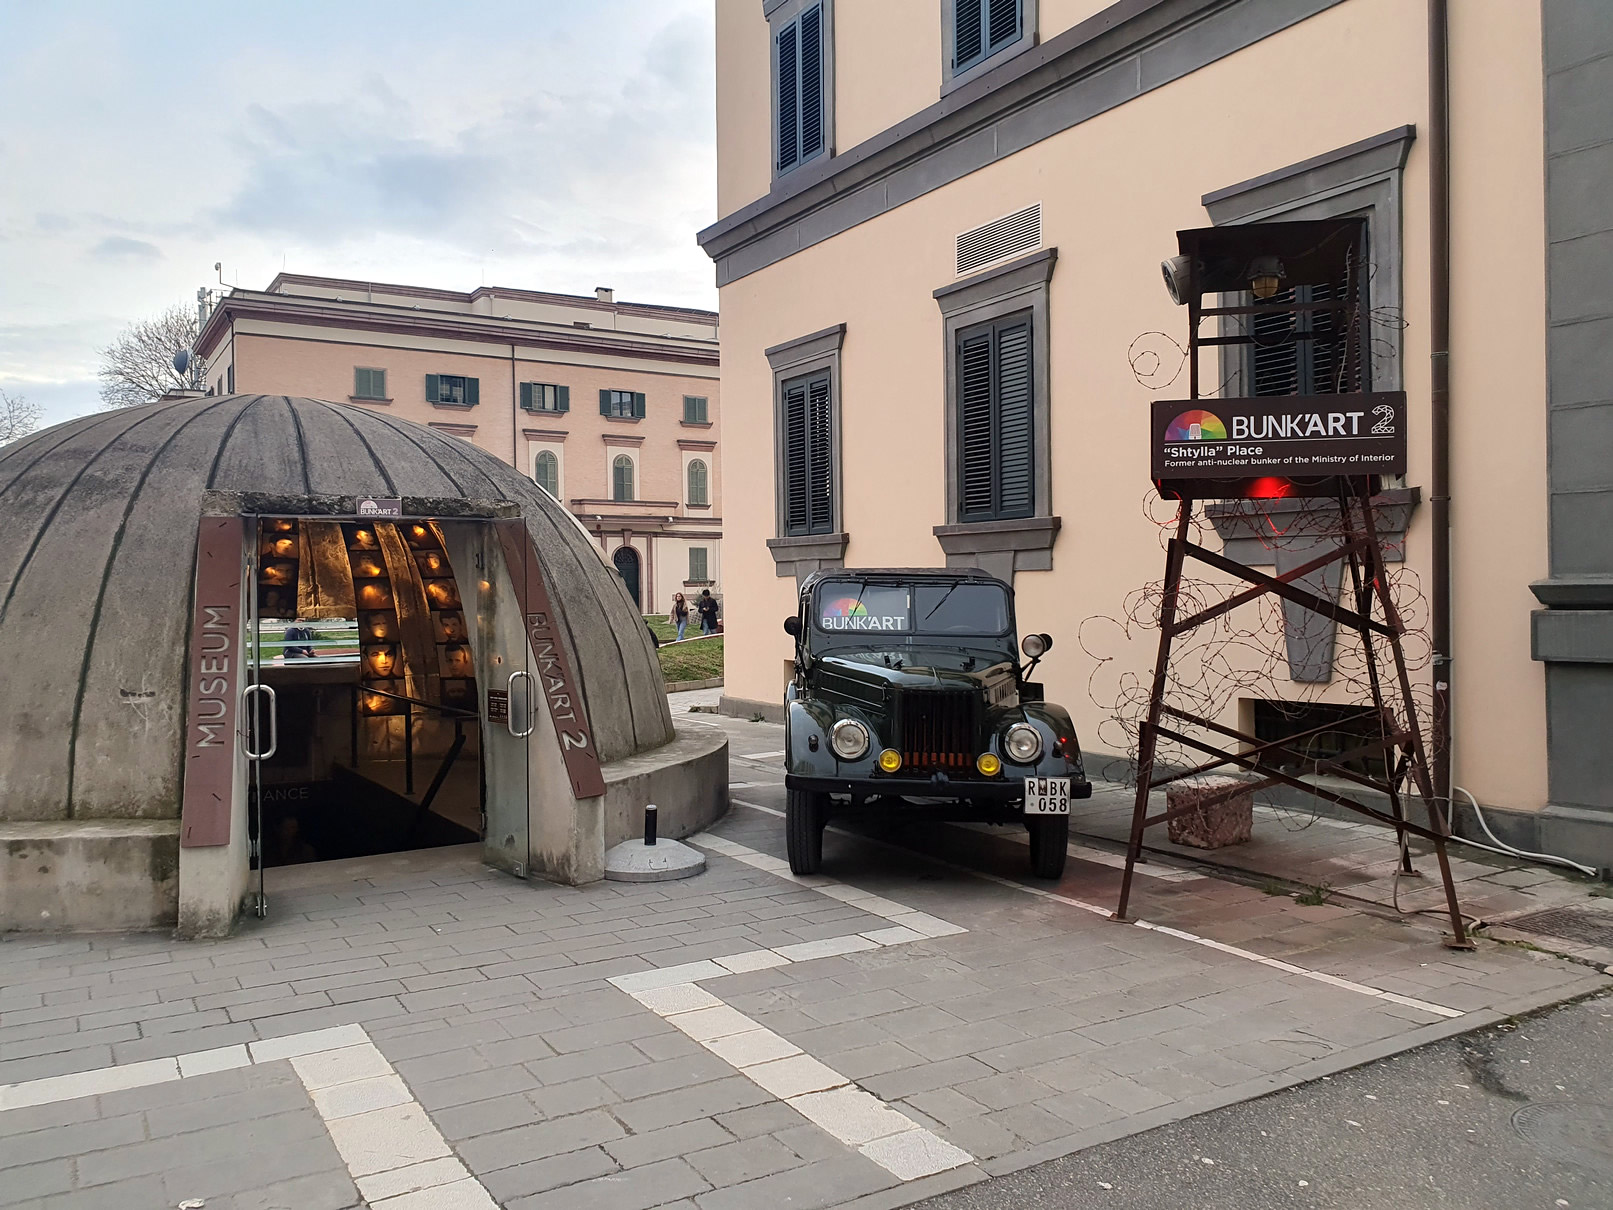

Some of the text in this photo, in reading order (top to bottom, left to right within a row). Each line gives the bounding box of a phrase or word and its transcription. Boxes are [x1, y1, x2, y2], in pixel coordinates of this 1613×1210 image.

[1231, 404, 1395, 439] BUNK'ART 2
[1164, 445, 1264, 459] “Shtylla” Place
[1164, 453, 1395, 467] Former anti-nuclear bunker of the Ministry of Interior
[392, 507, 399, 515] 2
[822, 616, 905, 630] BUNK'ART
[196, 605, 231, 748] MUSEUM
[561, 729, 588, 751] 2
[263, 787, 309, 801] ANCE
[1028, 780, 1067, 797] R BK
[1038, 797, 1067, 812] 058
